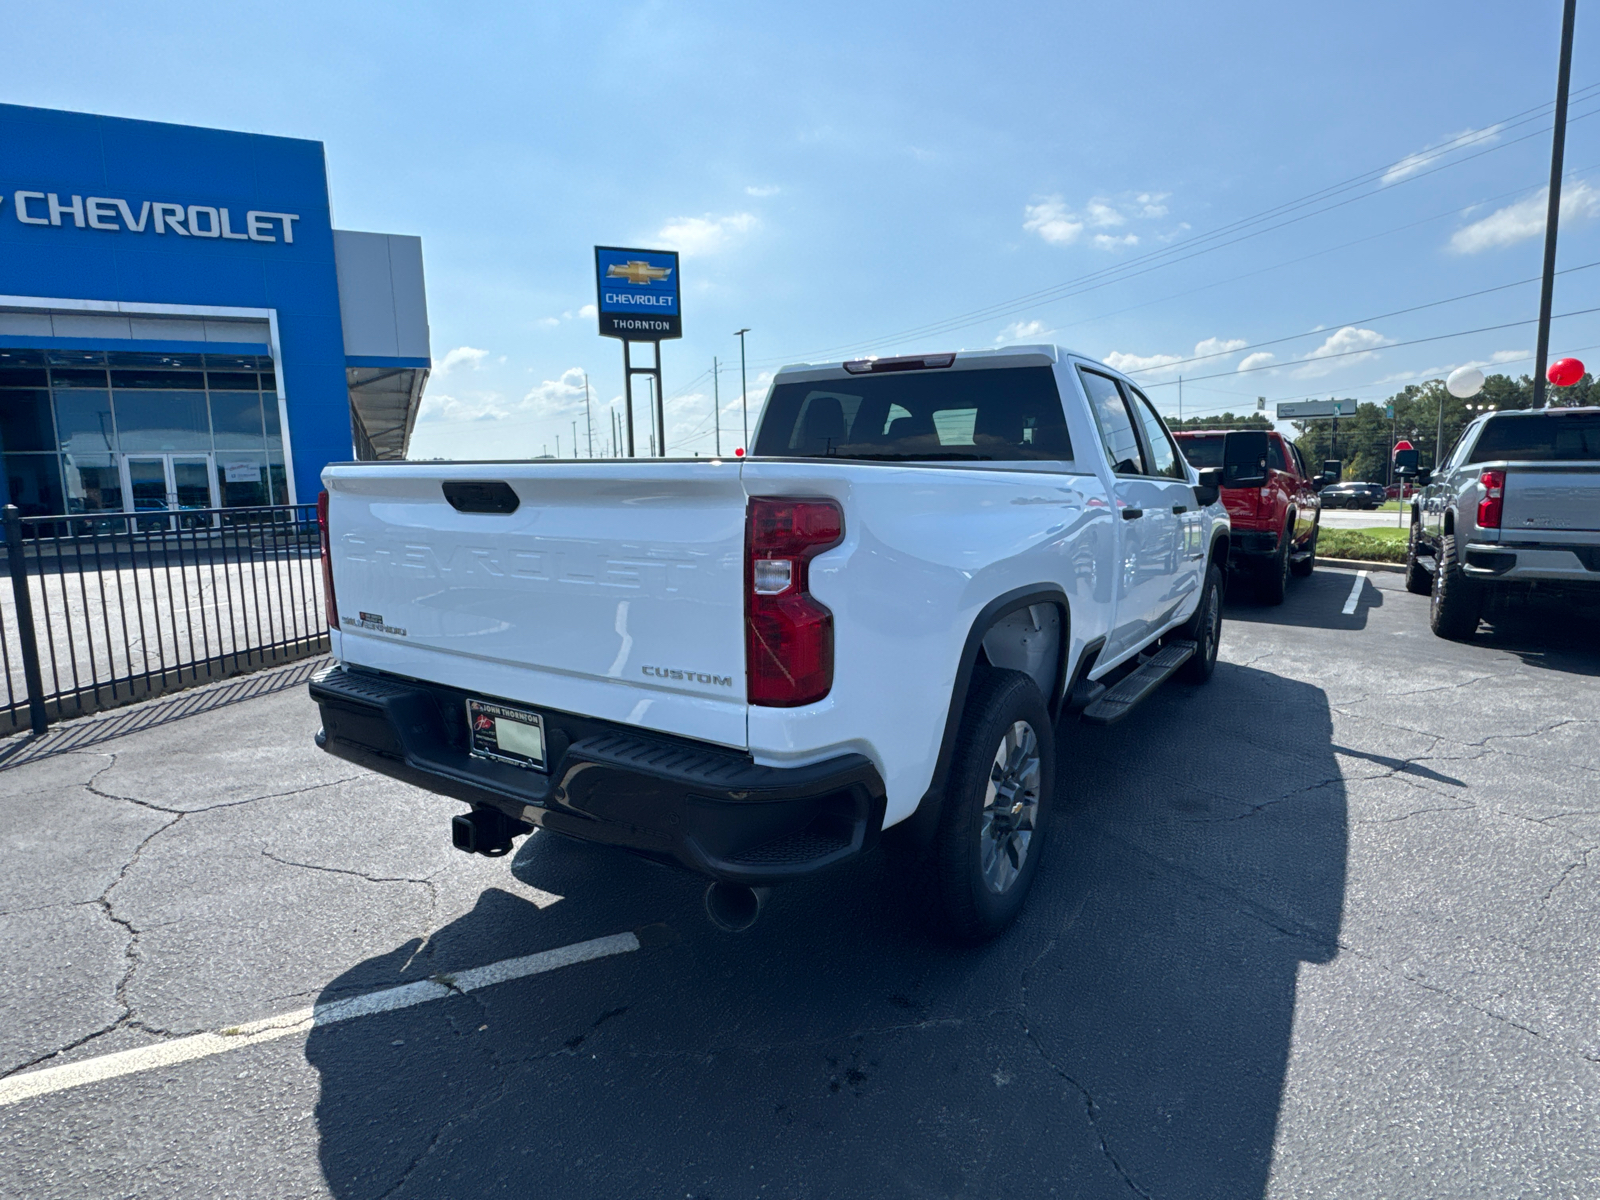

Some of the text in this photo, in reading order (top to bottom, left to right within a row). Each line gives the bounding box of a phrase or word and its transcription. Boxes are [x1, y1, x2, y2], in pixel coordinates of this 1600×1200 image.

[14, 190, 300, 244] CHEVROLET
[605, 293, 673, 306] CHEVROLET
[612, 319, 670, 330] THORNTON
[641, 665, 732, 687] CUSTOM
[483, 704, 501, 715] JOHN
[501, 708, 539, 724] THORNTON
